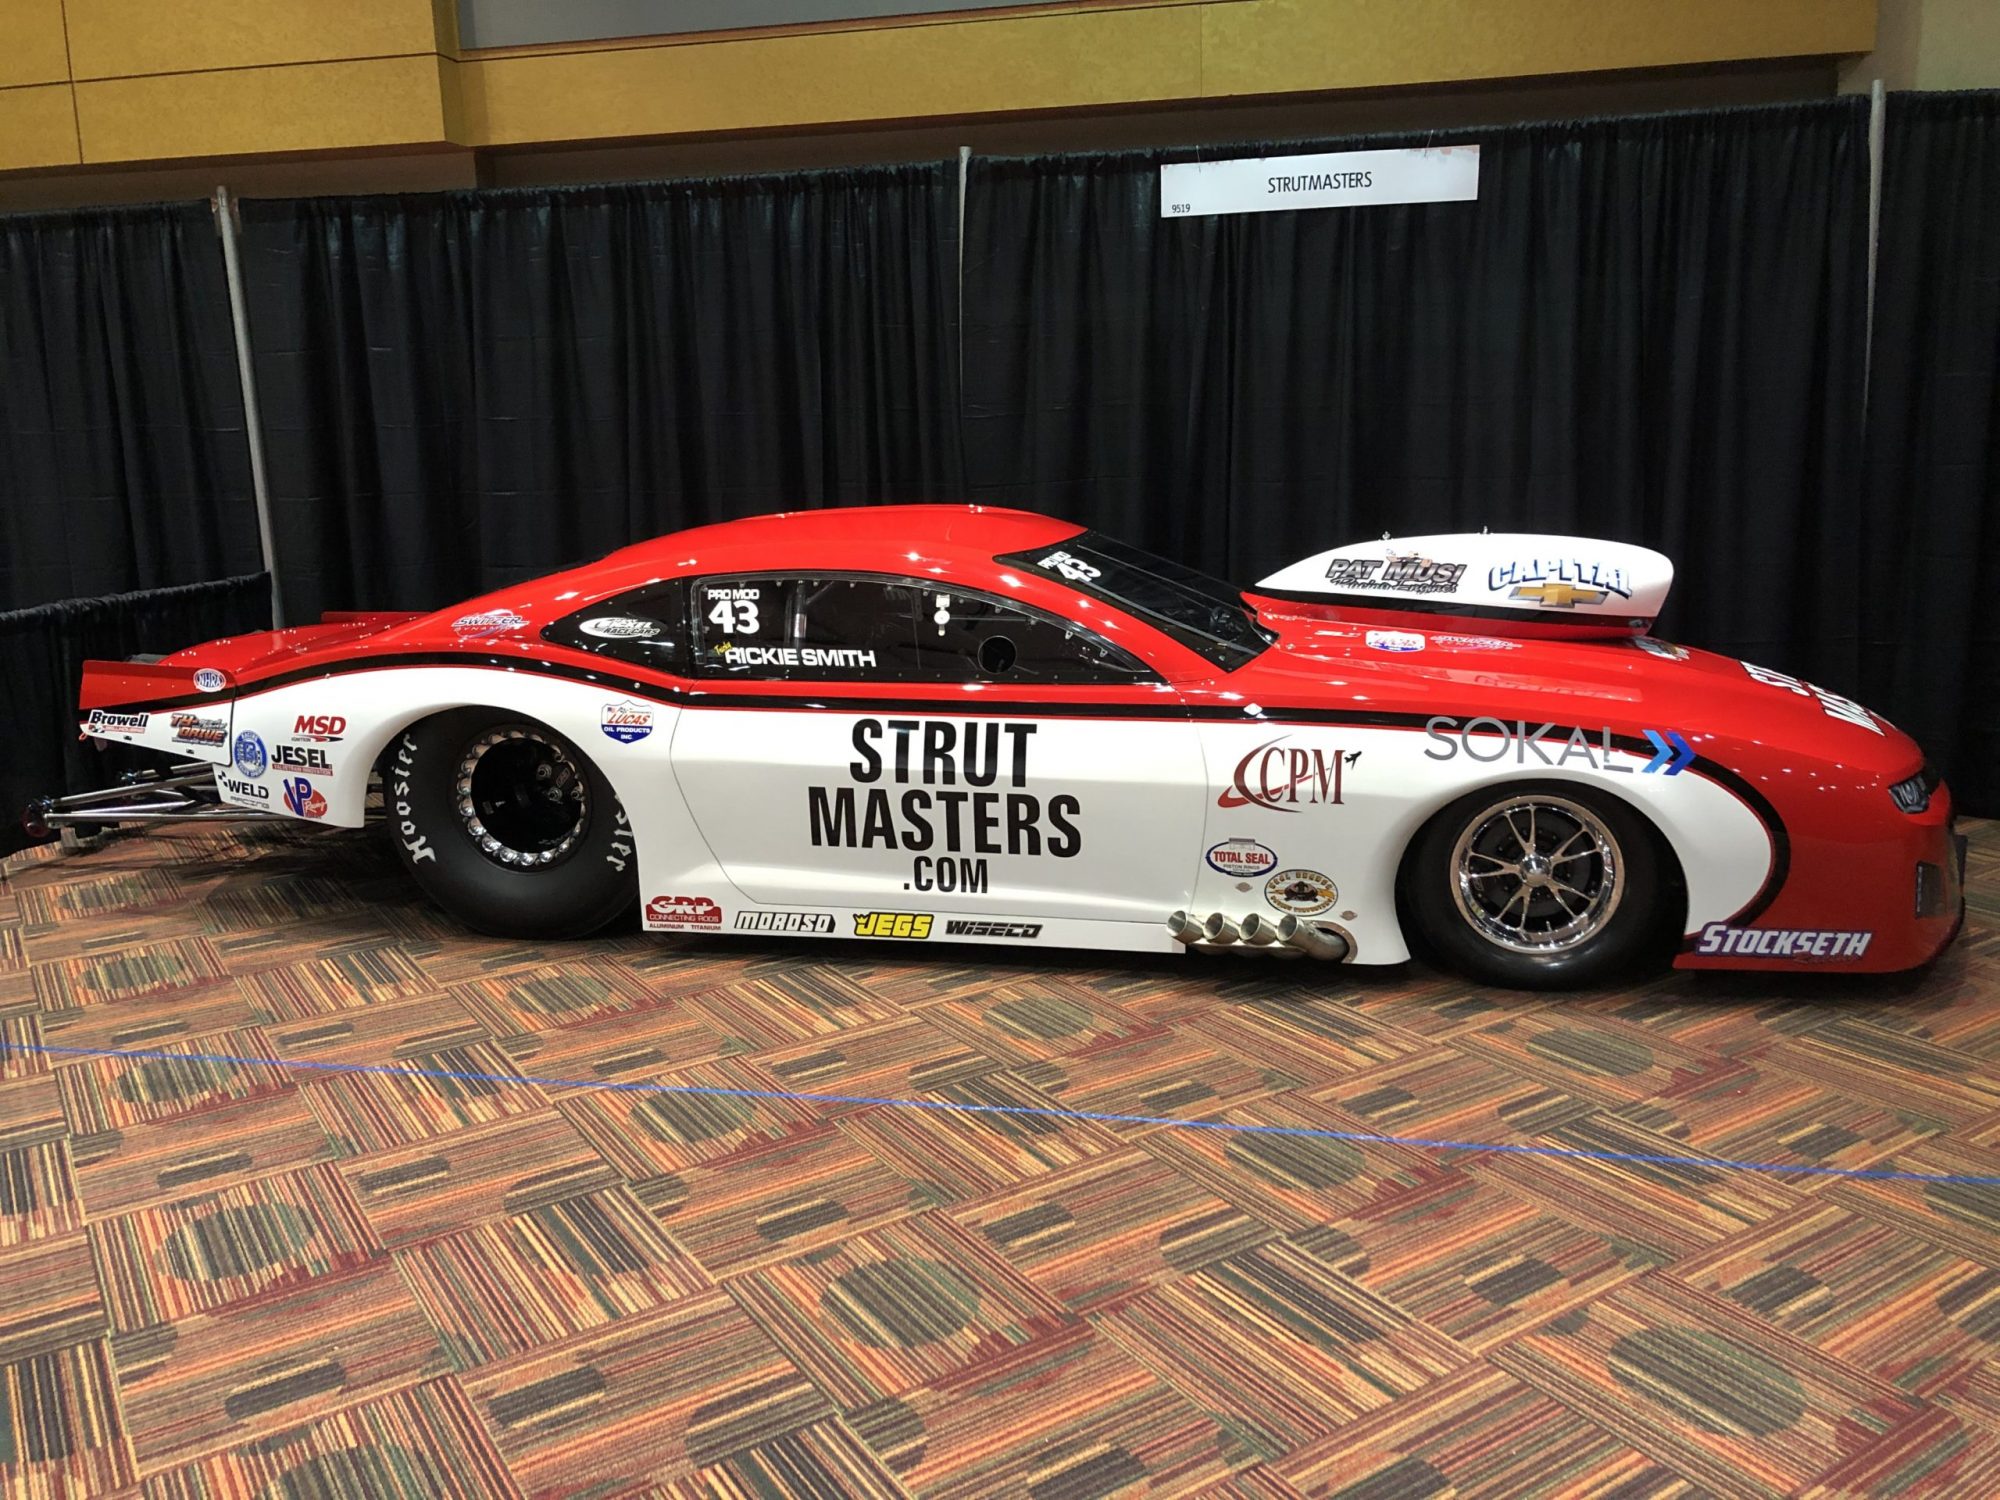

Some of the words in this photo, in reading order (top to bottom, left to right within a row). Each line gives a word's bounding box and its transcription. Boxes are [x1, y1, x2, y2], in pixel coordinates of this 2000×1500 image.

[1267, 171, 1373, 194] STRUTMASTERS
[1171, 203, 1191, 214] 9519
[1325, 558, 1384, 580] PAT
[1381, 562, 1468, 583] MUSI
[1487, 557, 1633, 600] CAPITAL
[707, 588, 732, 601] PRO
[732, 588, 760, 601] MOD
[707, 600, 761, 635] 43
[630, 627, 660, 635] CARS
[724, 646, 800, 666] RICKIE
[800, 648, 878, 668] SMITH
[197, 672, 223, 688] NHRA
[90, 711, 150, 728] Browell
[293, 715, 347, 735] MSD
[607, 713, 651, 725] LUCAS
[849, 718, 1038, 788] STRUT
[1423, 716, 1634, 774] SOKAL
[271, 745, 333, 770] JESEL
[228, 779, 269, 799] WELD
[283, 777, 312, 817] VP
[391, 733, 436, 865] Hoosier
[807, 786, 1083, 859] MASTERS
[1213, 850, 1244, 864] TOTAL
[1245, 852, 1271, 865] SEAL
[903, 855, 988, 894] .COM
[651, 895, 715, 915] GRP
[650, 913, 696, 923] CONNECTING
[697, 915, 719, 923] RODS
[734, 911, 834, 933] MOROSO
[854, 911, 934, 939] JEGS
